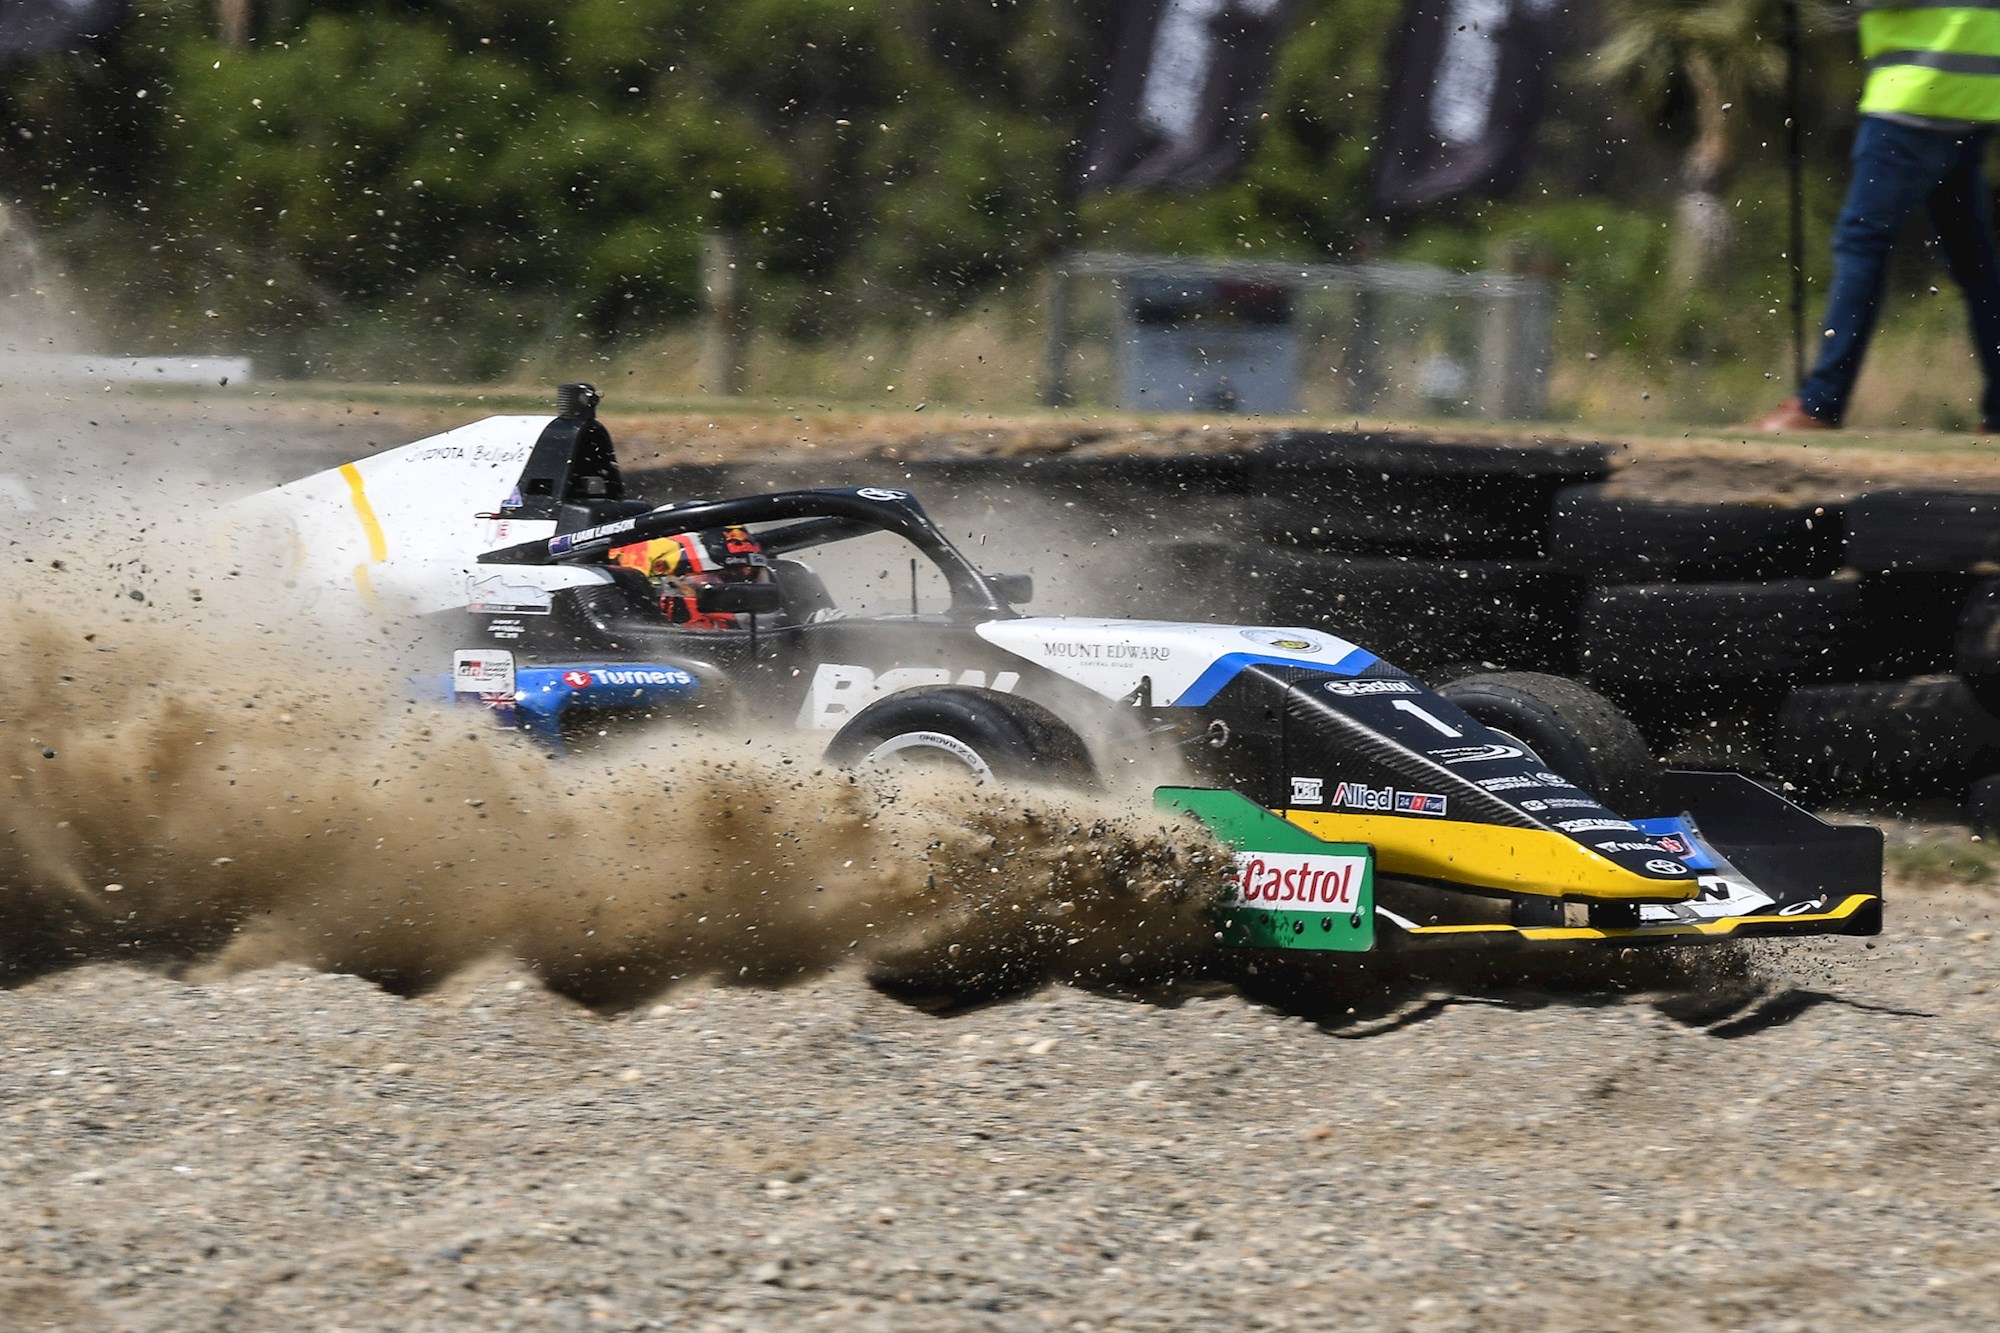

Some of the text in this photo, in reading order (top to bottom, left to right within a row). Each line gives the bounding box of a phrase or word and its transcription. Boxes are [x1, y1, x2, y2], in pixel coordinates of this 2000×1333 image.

[1043, 642, 1170, 661] MOUNT EDWARD
[590, 669, 692, 686] Turners
[1348, 681, 1415, 694] Castrol
[1391, 699, 1463, 738] 1
[1332, 782, 1393, 810] Allied
[1243, 858, 1353, 904] Castrol
